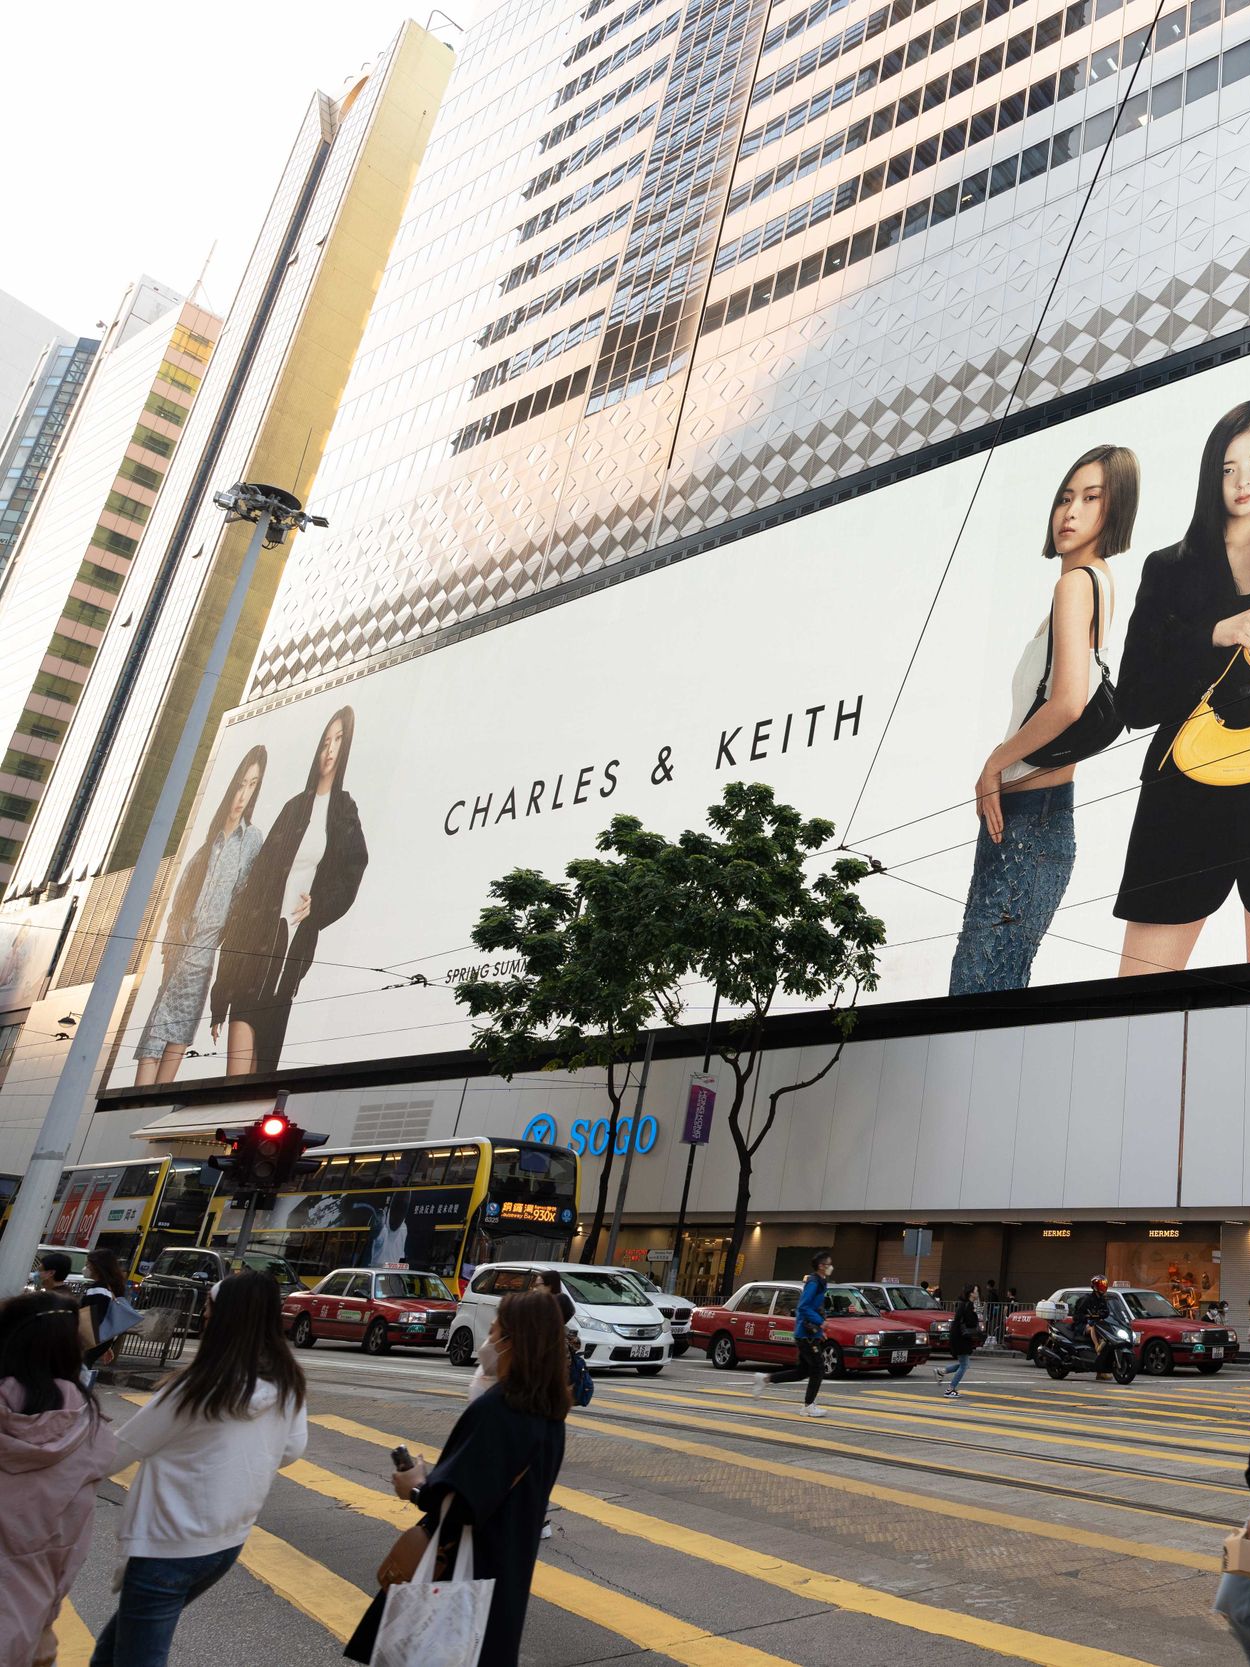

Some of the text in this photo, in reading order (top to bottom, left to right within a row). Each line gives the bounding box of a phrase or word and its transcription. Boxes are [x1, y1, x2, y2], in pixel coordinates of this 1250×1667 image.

[444, 695, 863, 836] CHARLES & KEITH
[445, 963, 490, 984] SPRING
[568, 1115, 659, 1156] SOGO
[533, 1210, 556, 1222] 930X
